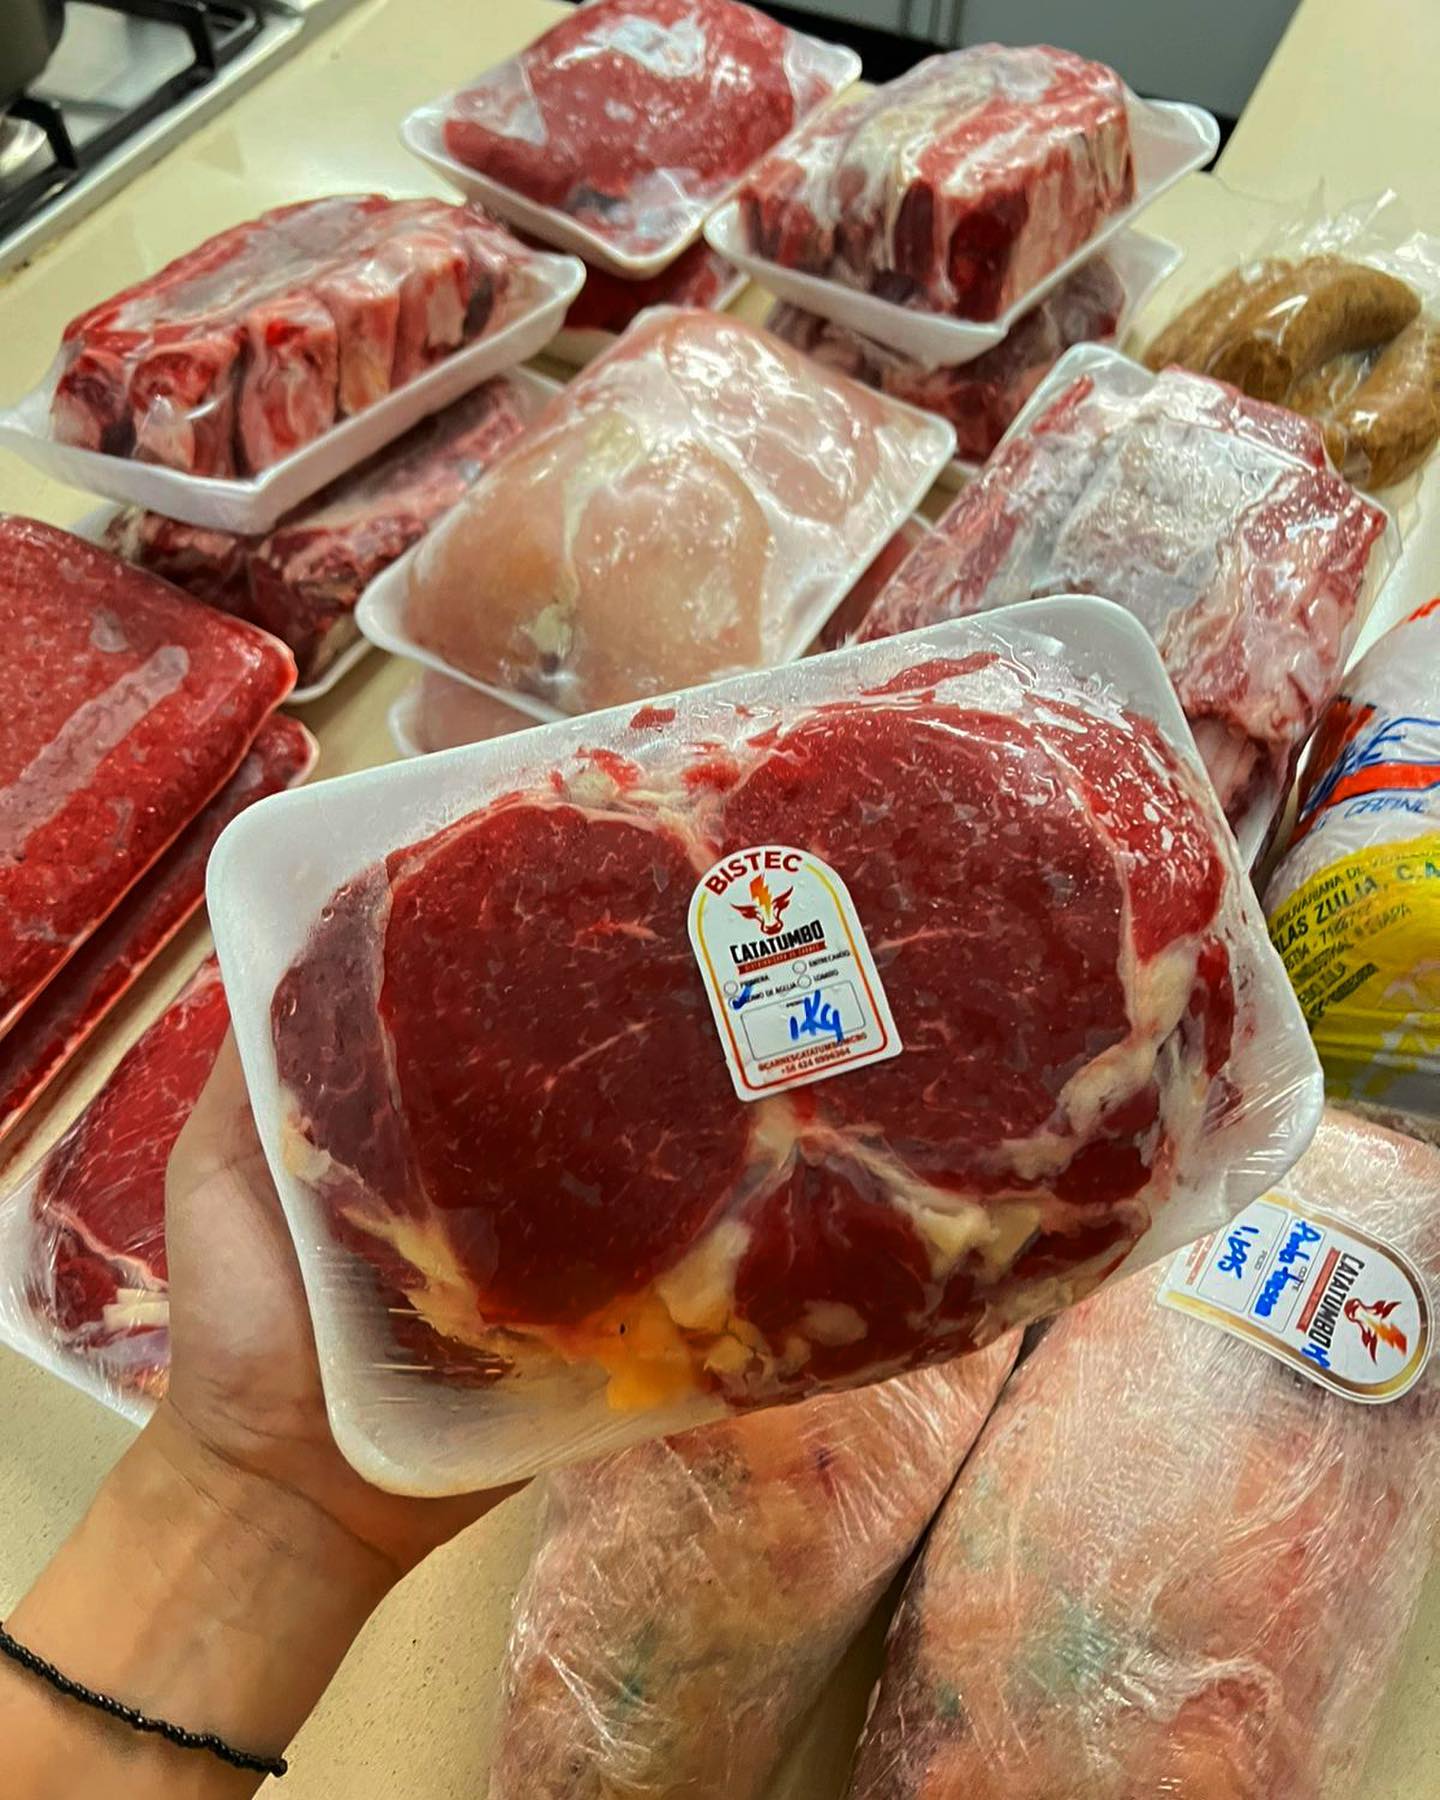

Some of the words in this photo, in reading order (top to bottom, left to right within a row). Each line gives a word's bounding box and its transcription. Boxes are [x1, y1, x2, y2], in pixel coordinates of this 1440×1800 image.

[705, 851, 803, 895] BISTEC
[729, 919, 825, 964] CATATUMBO
[1306, 1253, 1365, 1349] CATATUMBO
